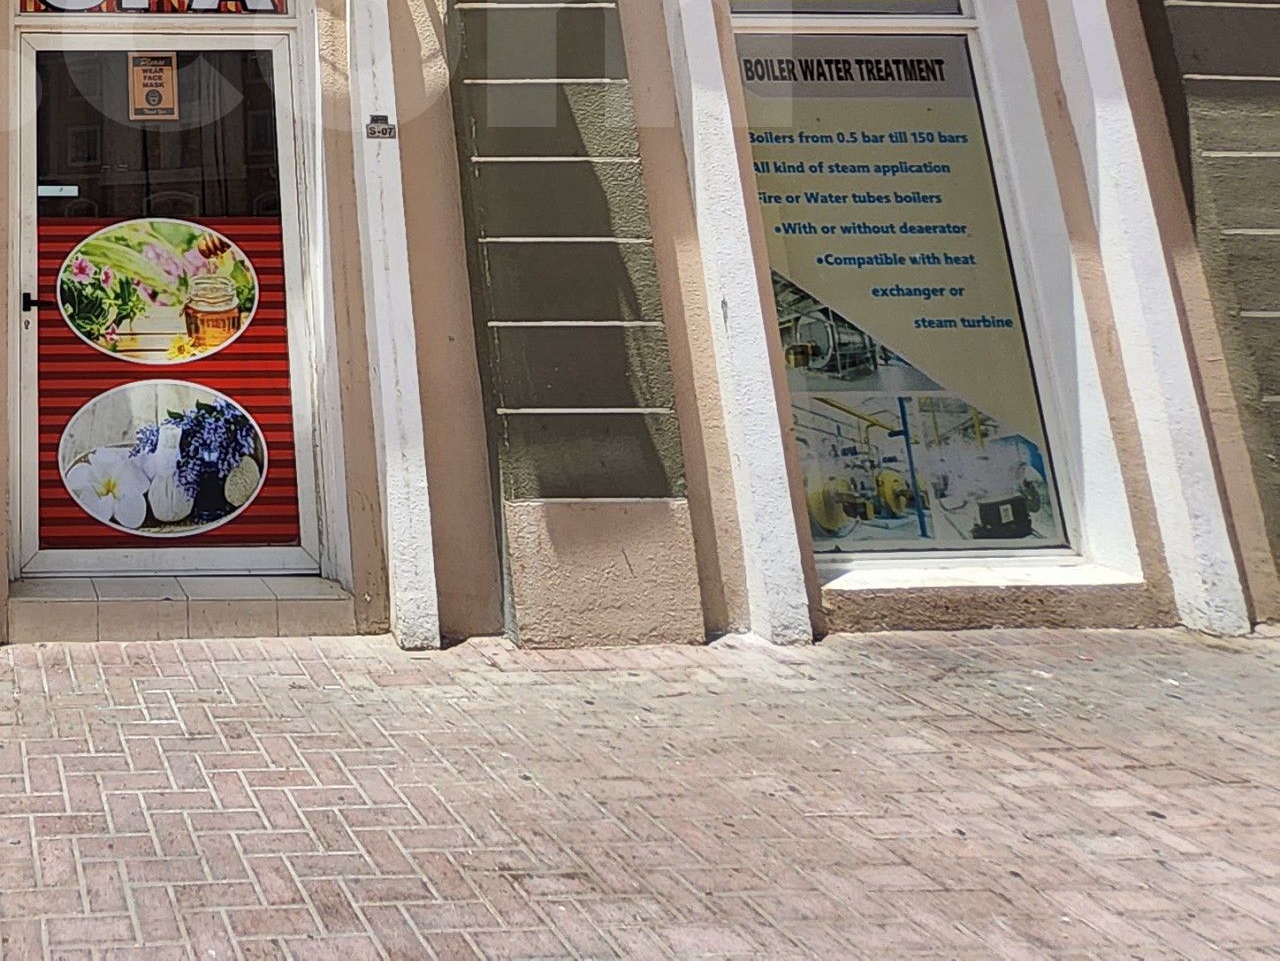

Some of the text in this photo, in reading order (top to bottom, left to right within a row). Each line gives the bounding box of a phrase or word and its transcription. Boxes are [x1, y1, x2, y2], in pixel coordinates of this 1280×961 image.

[743, 59, 946, 81] BOILER WATER TREATMENT
[369, 127, 394, 136] S-07
[798, 132, 834, 143] from
[837, 132, 858, 143] 0.5
[862, 132, 885, 143] bar
[888, 131, 908, 143] till
[912, 132, 934, 143] 150
[938, 132, 968, 143] bars
[754, 161, 951, 176] All kind of steam application
[786, 195, 800, 204] or
[804, 192, 848, 204] Water
[851, 192, 891, 204] tubes
[894, 192, 943, 204] boilers
[781, 222, 967, 234] With or without deaerator
[824, 254, 976, 268] Compatible with heat
[872, 285, 965, 300] exchanger or
[914, 316, 1014, 328] steam turbine
